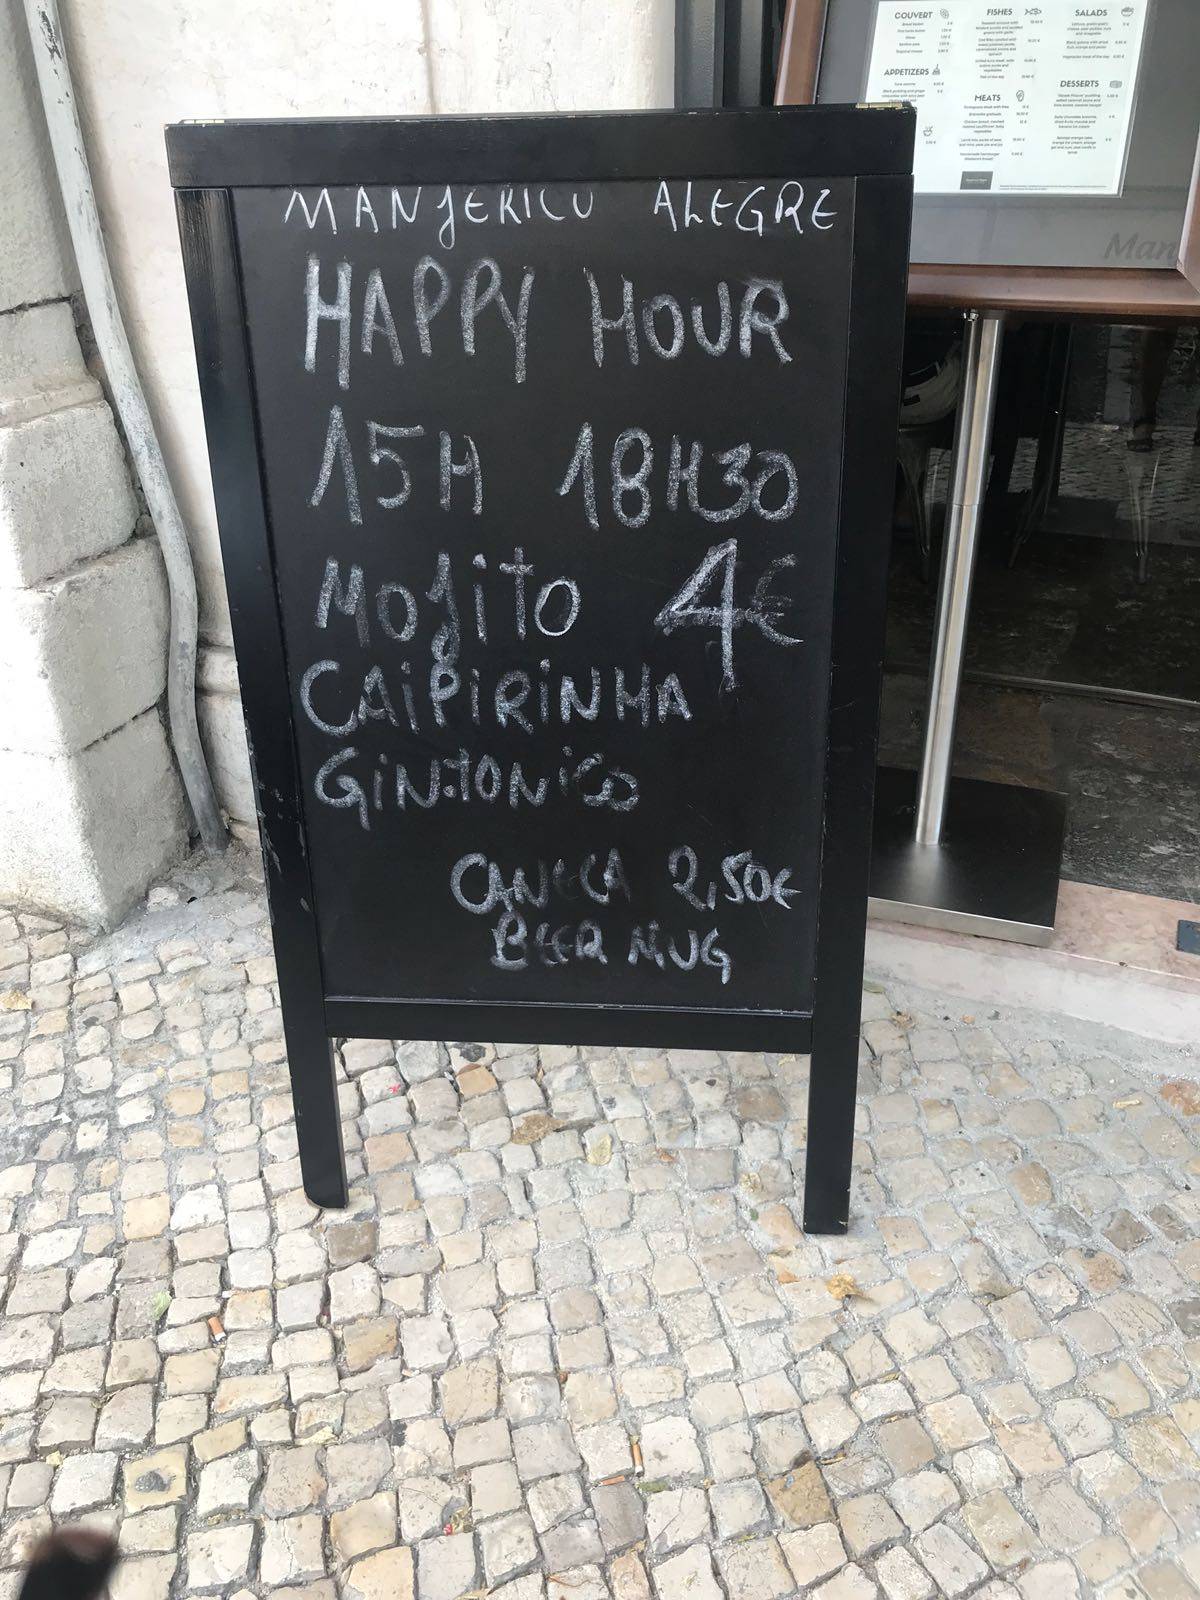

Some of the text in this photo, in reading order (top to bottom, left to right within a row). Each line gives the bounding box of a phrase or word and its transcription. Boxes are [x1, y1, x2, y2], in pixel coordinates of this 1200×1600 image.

[894, 11, 933, 19] COUVERT
[986, 8, 1013, 16] FISHES
[1074, 9, 1108, 17] SALADS
[884, 68, 930, 76] APPETIZERS
[1059, 80, 1100, 88] DESSERTS
[974, 94, 1001, 102] MEATS
[654, 181, 838, 237] ALEGRE
[304, 252, 793, 390] HAPPY HOUR
[555, 421, 798, 531] 18H30
